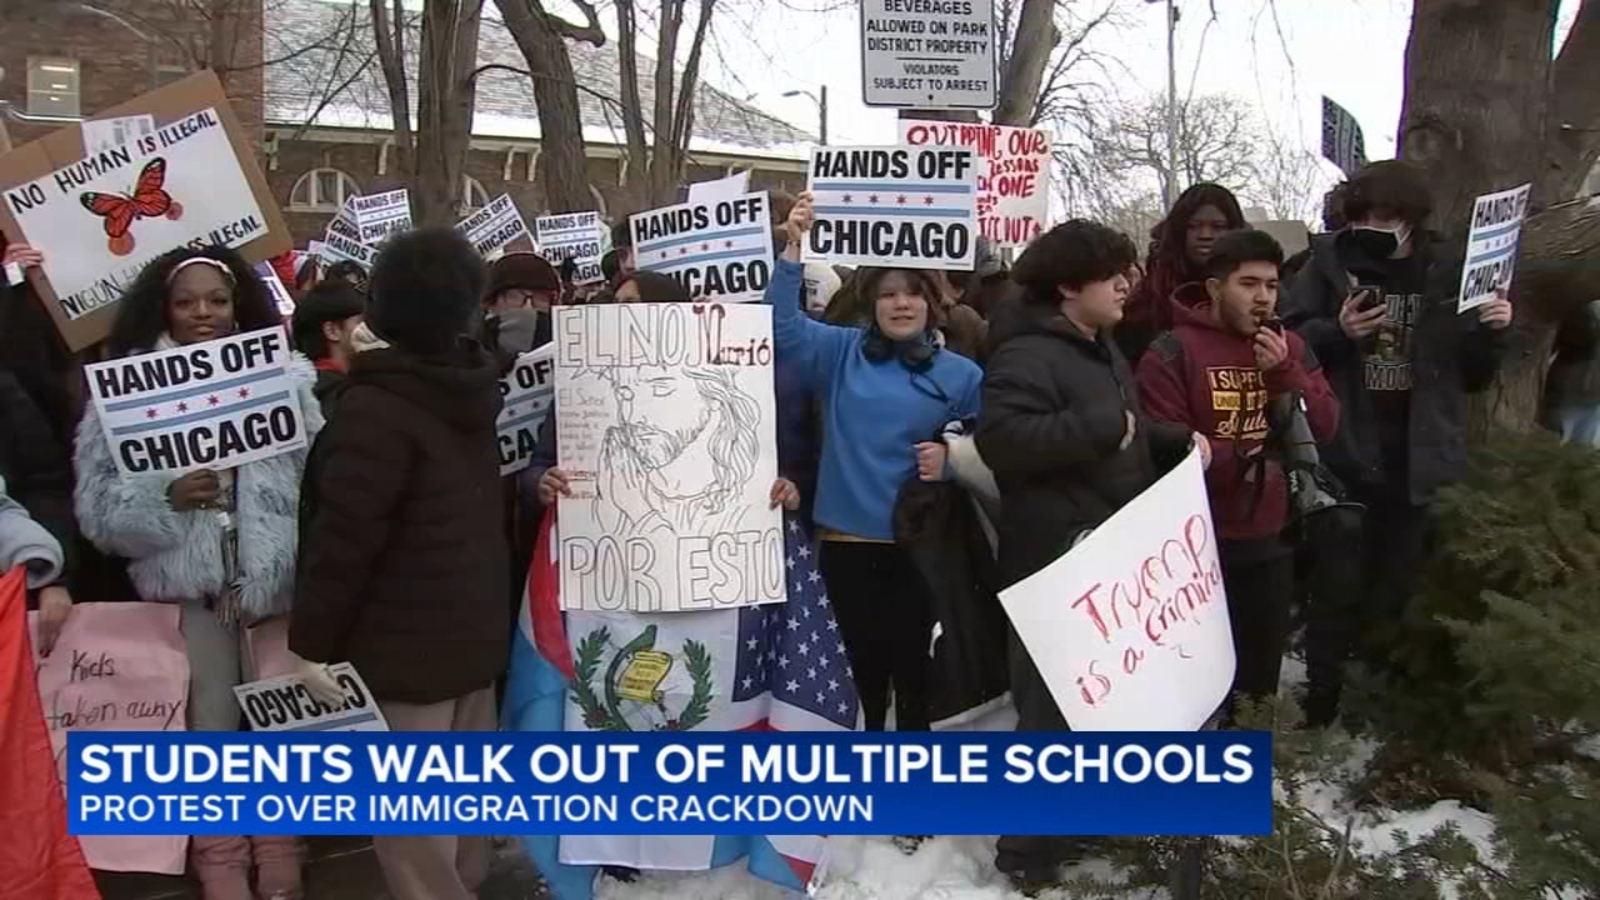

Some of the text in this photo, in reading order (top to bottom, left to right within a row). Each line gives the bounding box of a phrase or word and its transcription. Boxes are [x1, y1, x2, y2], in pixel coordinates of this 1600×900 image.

[884, 1, 972, 14] BEVERAGES
[867, 19, 988, 36] ALLOWED ON PARK
[868, 37, 988, 54] DISTRICT PROPERTY
[873, 77, 988, 91] SUBJECT TO ARREST
[903, 63, 959, 75] VIOLATORS
[9, 183, 46, 214] NO
[54, 146, 131, 194] HUMAN
[137, 135, 156, 156] IS
[159, 111, 216, 148] ILLEGAL
[814, 150, 970, 180] HANDS OFF
[540, 216, 576, 231] HANDS
[635, 197, 762, 242] HANDS OFF
[809, 218, 970, 260] CHICAGO
[94, 333, 280, 398] HANDS OFF
[119, 406, 297, 472] CHICAGO
[563, 529, 786, 611] POR ESTO
[1123, 647, 1144, 674] a
[245, 674, 367, 728] CCAGO
